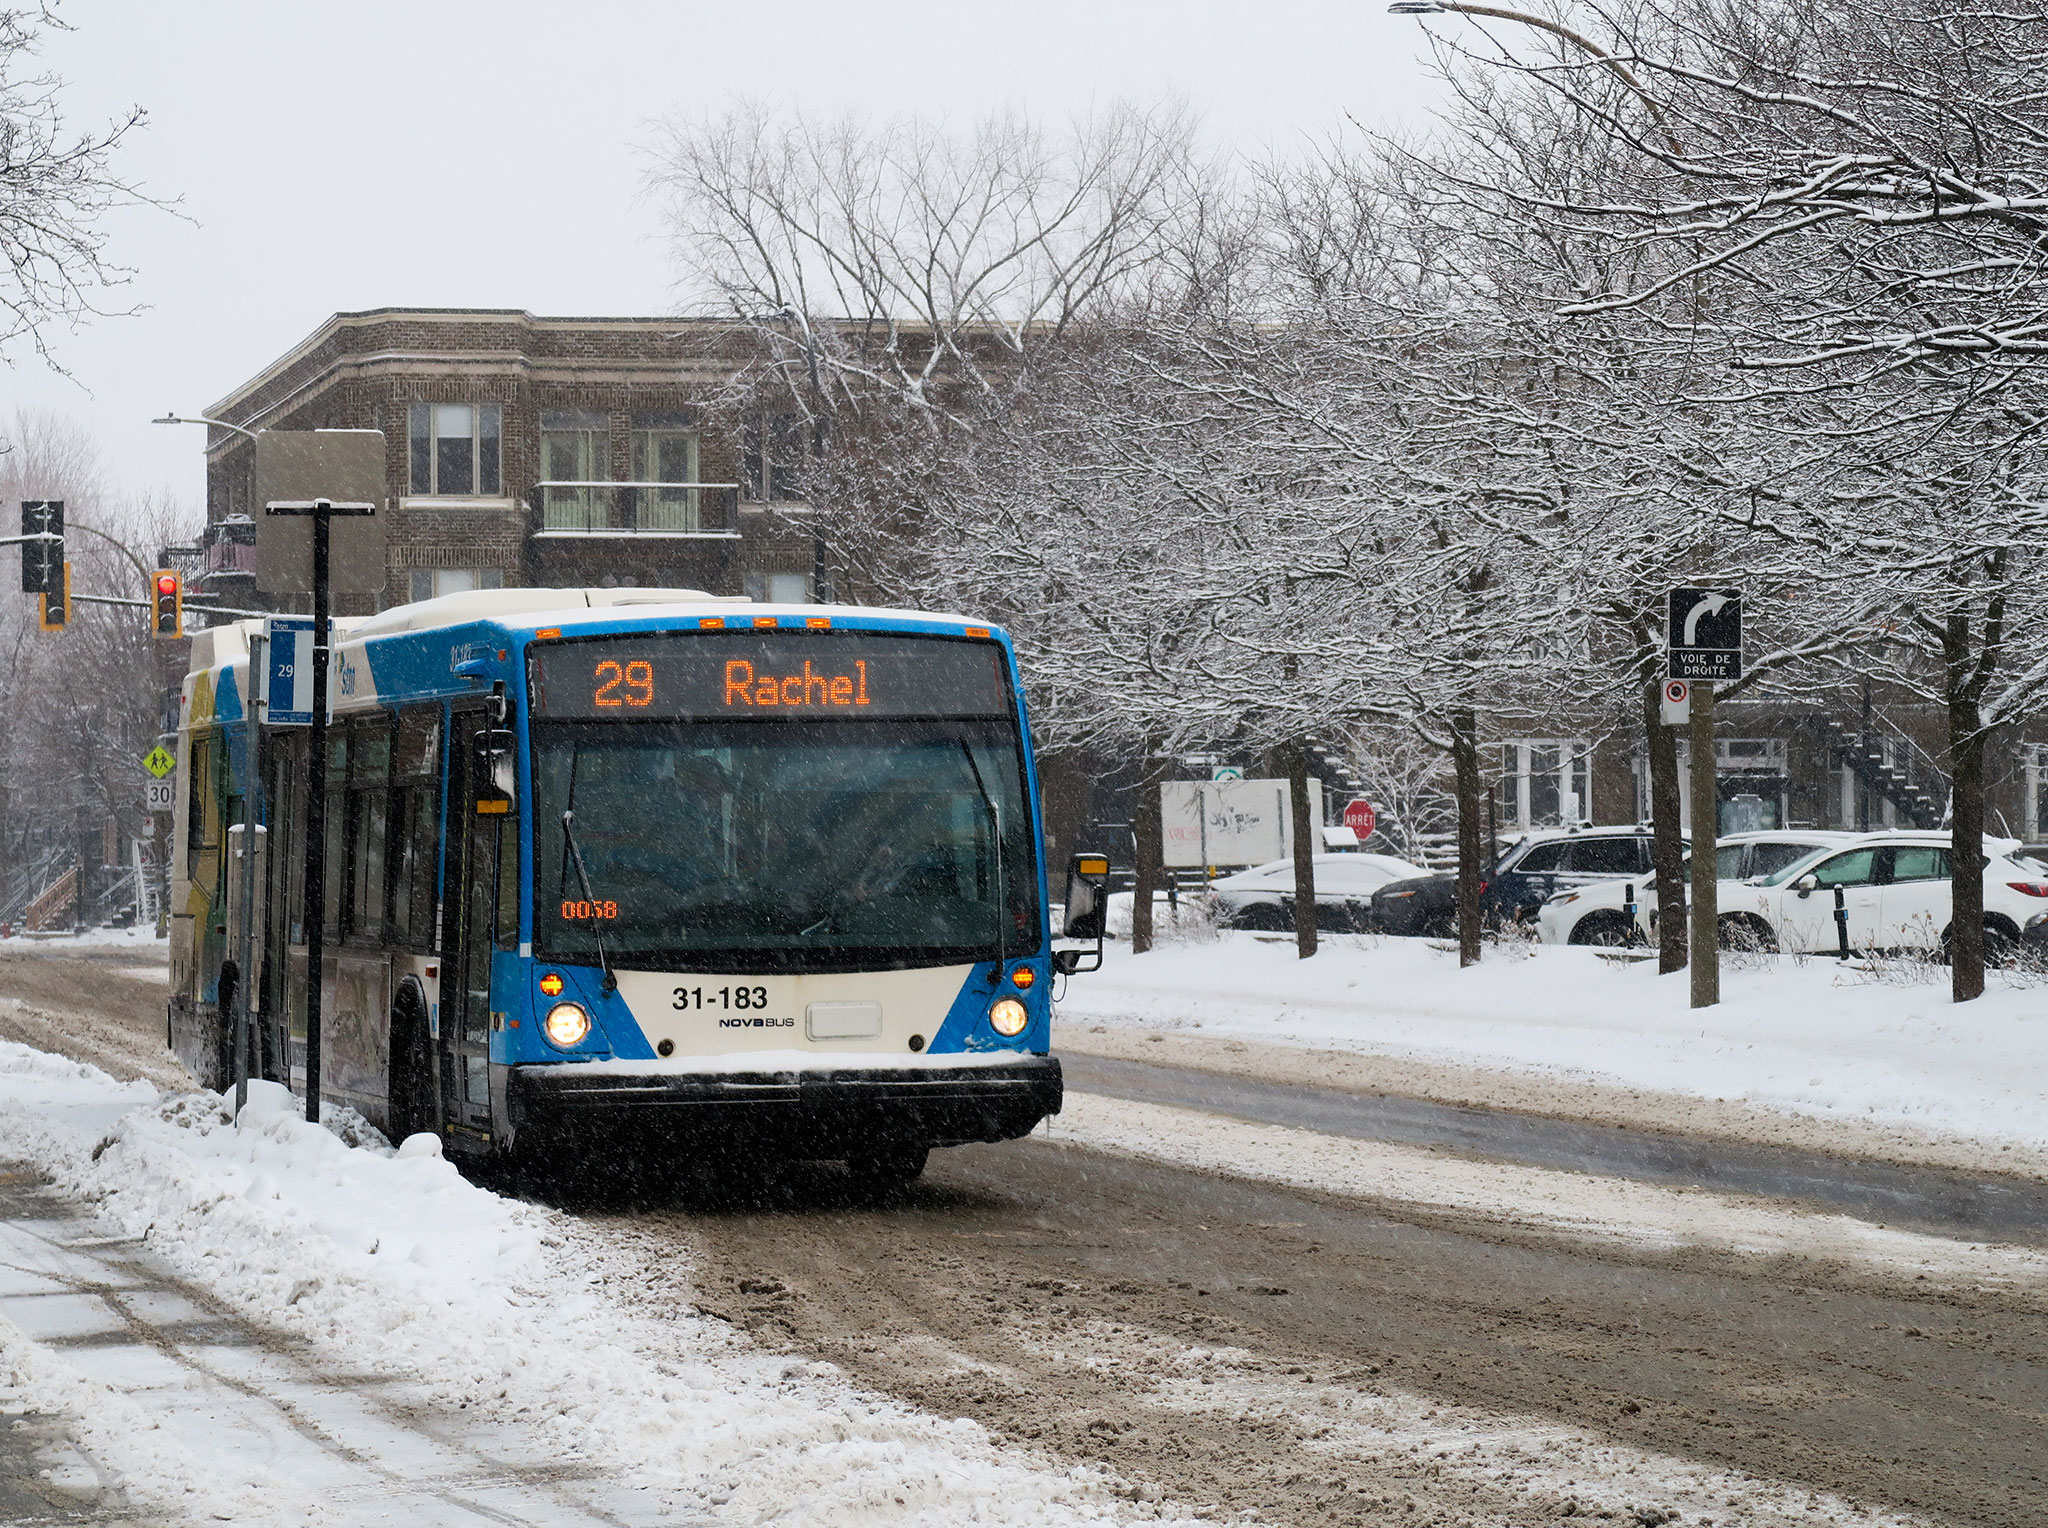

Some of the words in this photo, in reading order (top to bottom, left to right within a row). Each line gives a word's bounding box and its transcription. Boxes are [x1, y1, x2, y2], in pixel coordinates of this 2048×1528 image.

[1681, 653, 1707, 665] VOIE
[1715, 654, 1731, 664] DE
[278, 664, 294, 678] 29
[1684, 666, 1727, 676] DROITE
[595, 660, 653, 706] 29
[725, 660, 870, 705] Rachel
[150, 786, 170, 803] 30
[1345, 812, 1374, 827] ARRÊT
[672, 986, 768, 1010] 31-183
